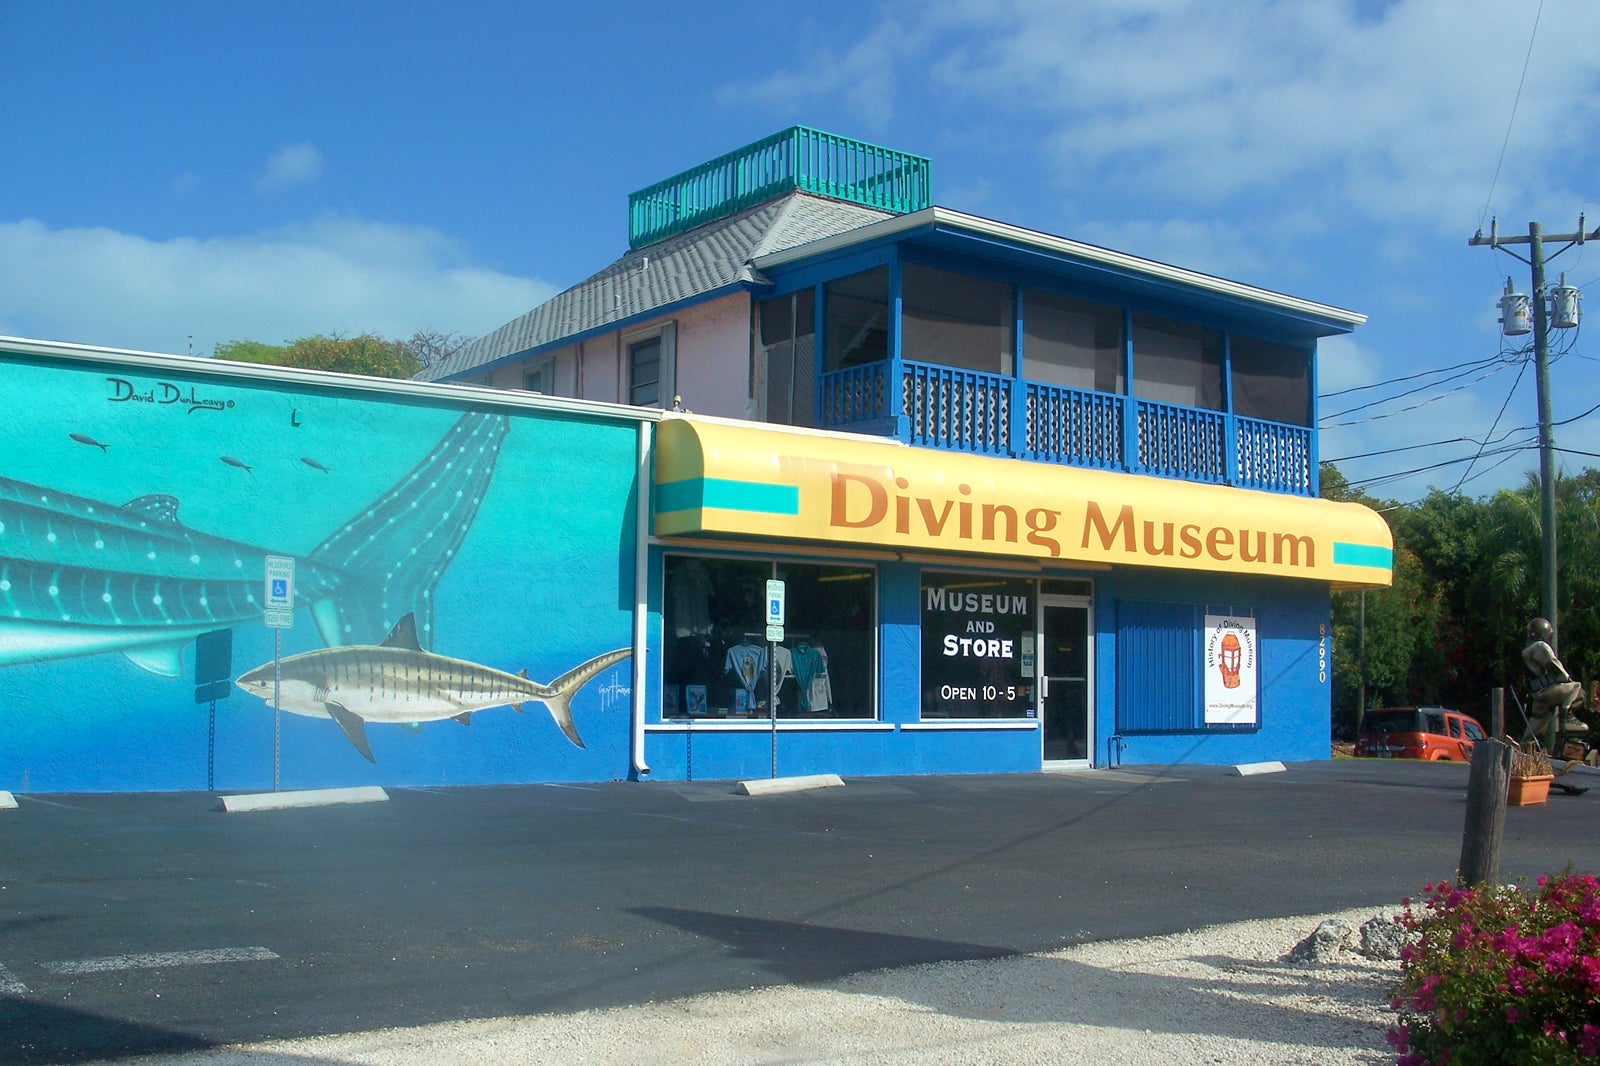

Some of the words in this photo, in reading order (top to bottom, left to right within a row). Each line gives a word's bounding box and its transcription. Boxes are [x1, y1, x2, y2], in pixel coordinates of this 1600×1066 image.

[106, 377, 155, 402] David
[830, 472, 1062, 558] Diving
[1081, 500, 1317, 568] Museum
[927, 588, 1027, 614] MUSEUM
[965, 620, 995, 633] AND
[943, 634, 1014, 659] STORE
[1208, 633, 1218, 668] History
[1216, 623, 1223, 634] of
[1223, 619, 1244, 633] Diving
[1243, 629, 1254, 669] Museum
[940, 684, 977, 701] OPEN
